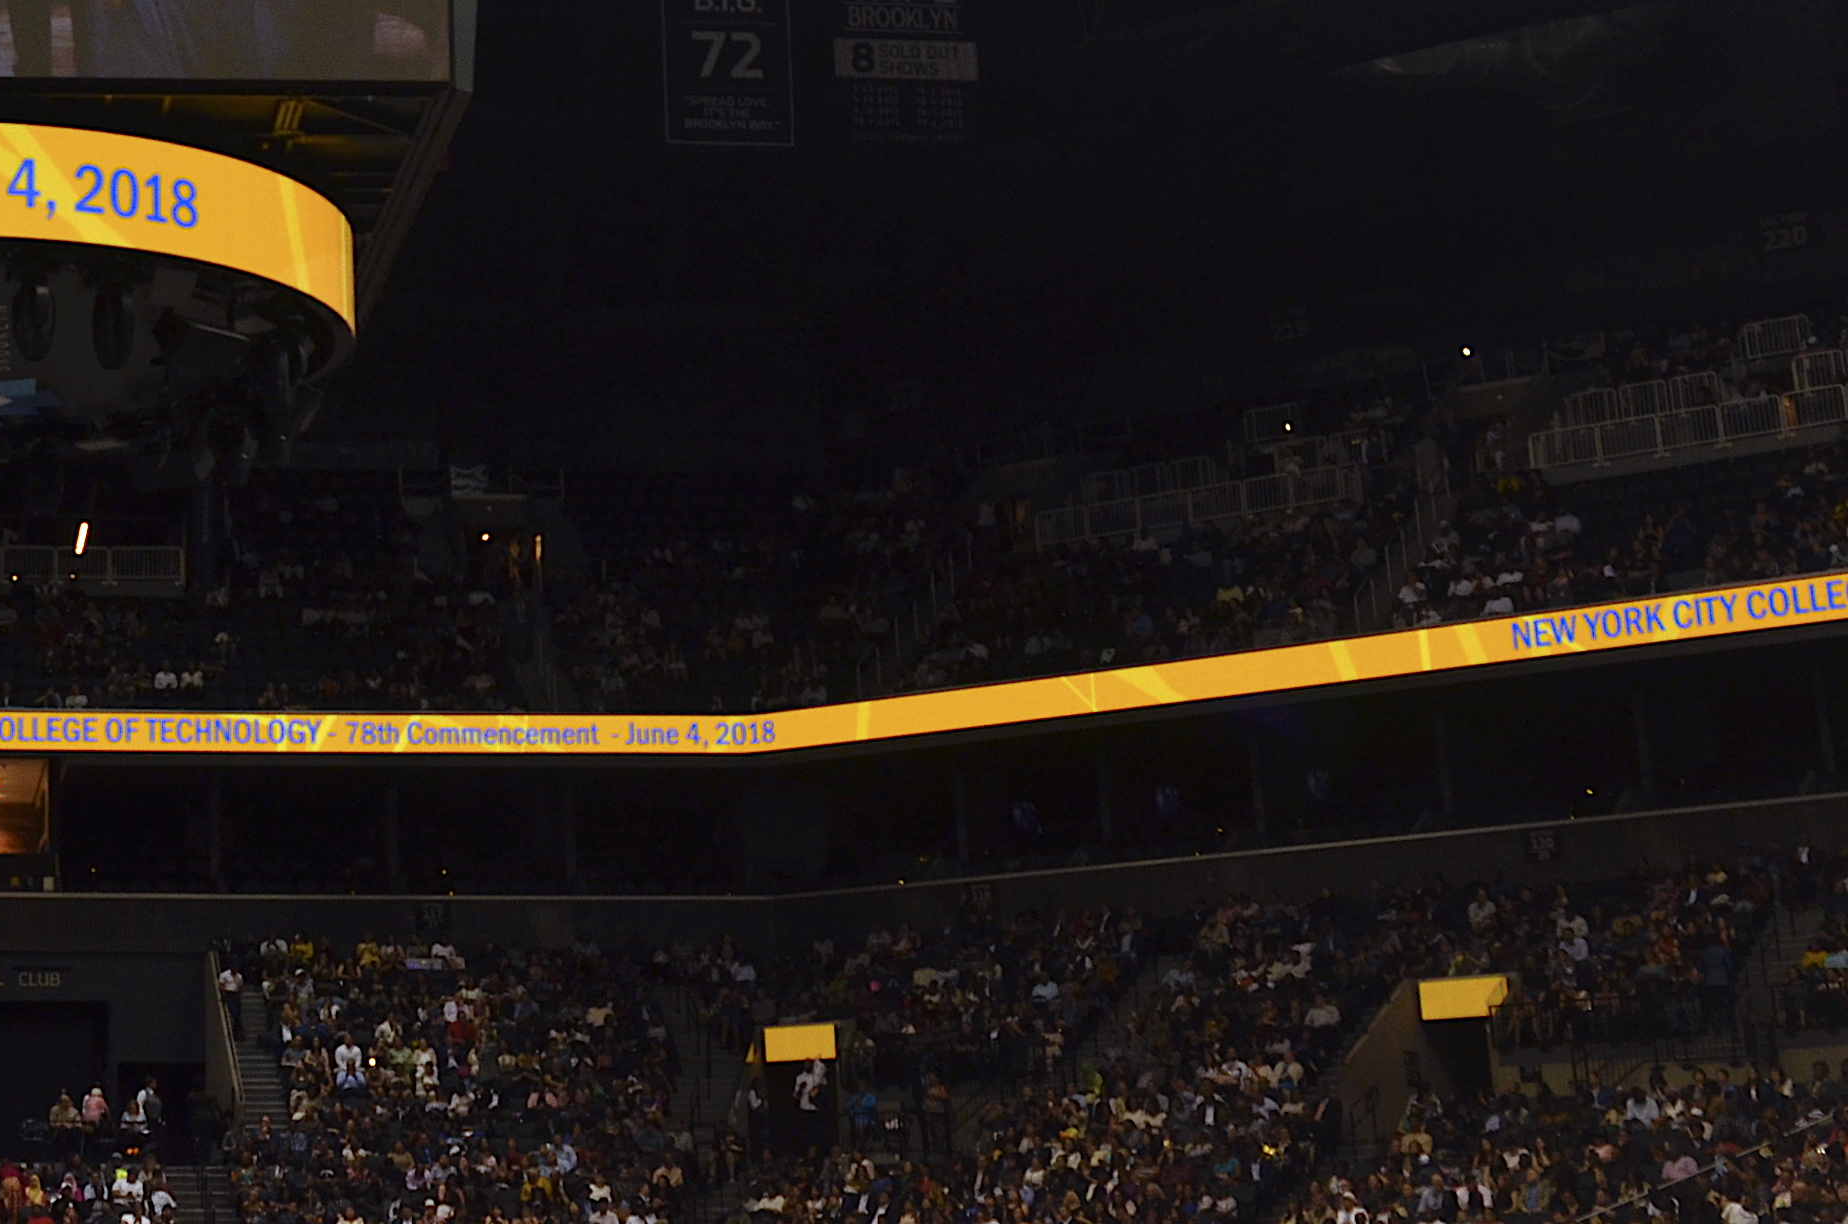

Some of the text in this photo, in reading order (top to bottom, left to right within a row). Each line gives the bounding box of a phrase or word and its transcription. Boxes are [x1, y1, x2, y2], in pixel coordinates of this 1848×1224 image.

[848, 5, 959, 30] BROOKLYN
[690, 30, 765, 80] 72
[852, 42, 875, 74] 8
[878, 44, 959, 61] SOLD OUT
[878, 60, 939, 77] SHOWS
[6, 158, 57, 220] 4,
[74, 163, 199, 230] 2018
[1763, 225, 1807, 251] 220
[1510, 579, 1848, 650] NEW YORK CITY COLLE
[105, 717, 140, 743] OF
[145, 718, 321, 745] TECHNOLOGY
[345, 720, 400, 745] 78th
[406, 720, 600, 746] Commencement
[625, 722, 680, 746] June
[685, 721, 709, 749] 4,
[715, 719, 776, 746] 2018
[18, 971, 61, 988] CLUB
